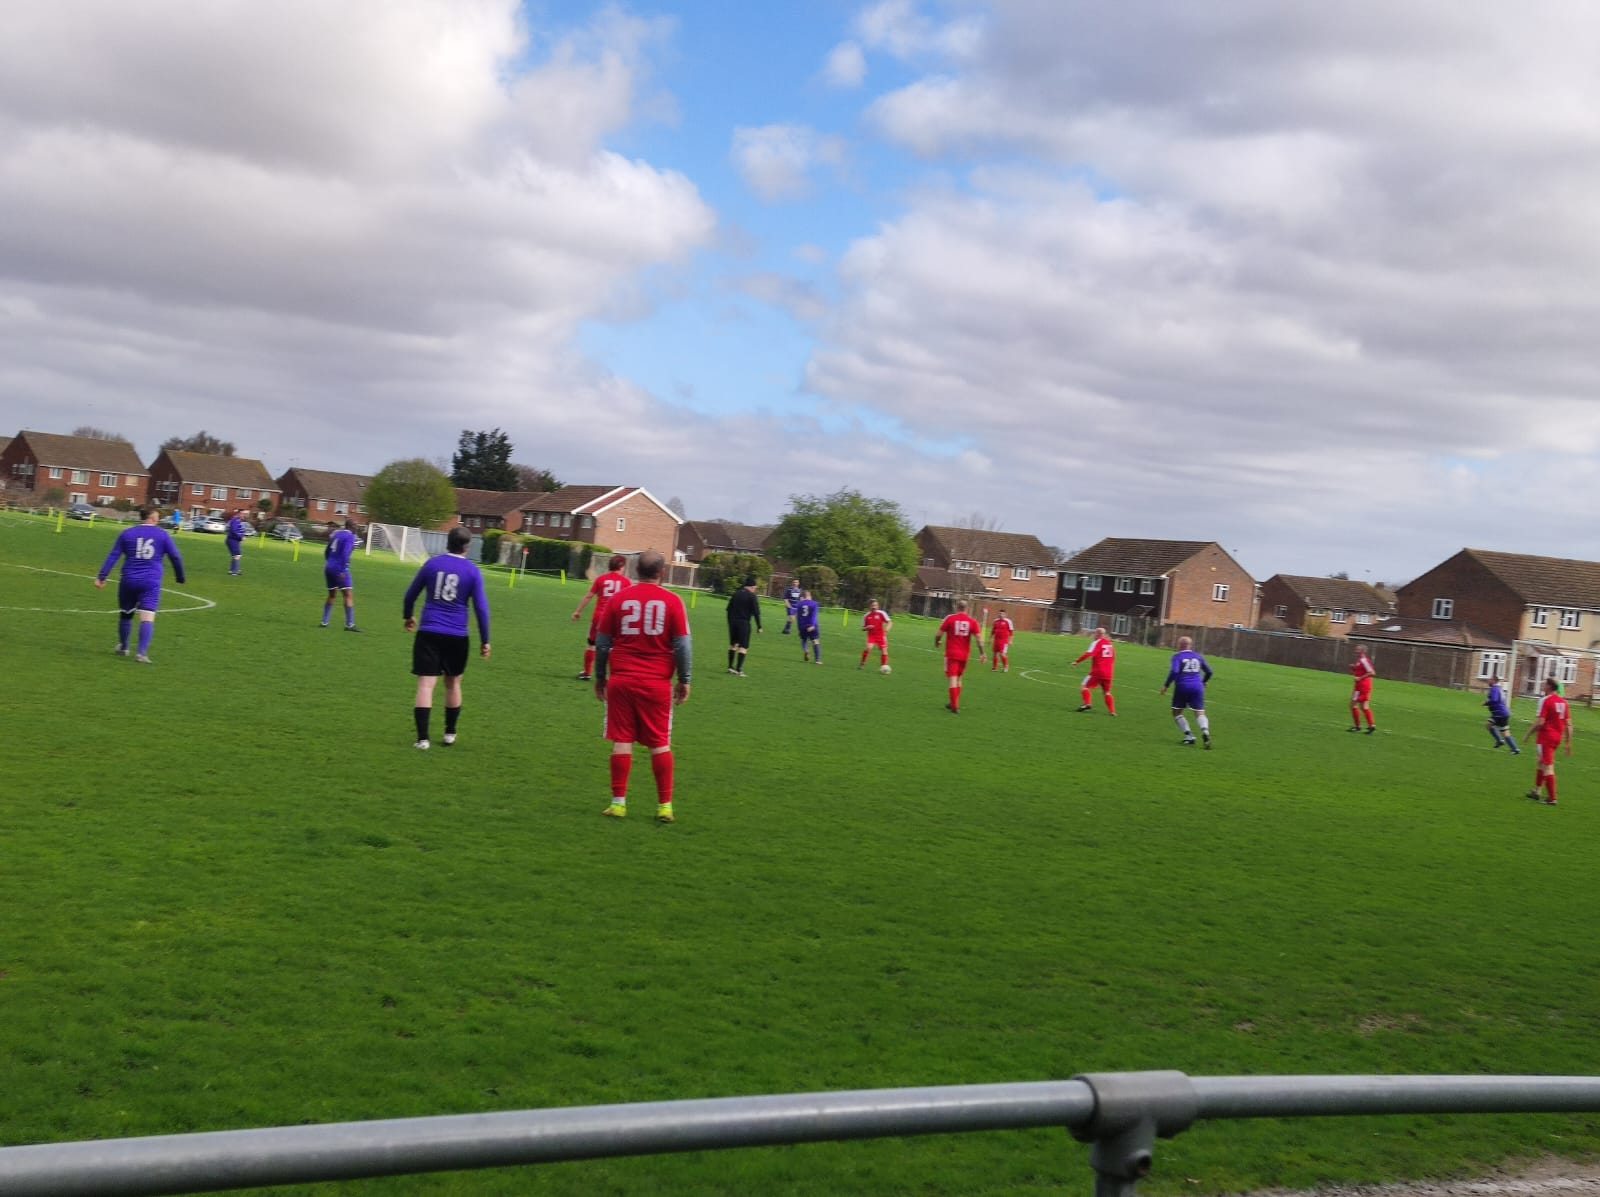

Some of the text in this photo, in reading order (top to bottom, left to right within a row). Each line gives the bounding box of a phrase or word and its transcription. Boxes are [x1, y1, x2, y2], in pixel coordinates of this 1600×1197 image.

[136, 537, 155, 560] 16
[433, 571, 460, 601] 18
[603, 580, 622, 597] 21
[621, 600, 667, 635] 20
[802, 605, 809, 616] 3
[954, 620, 970, 636] 19
[1182, 658, 1200, 672] 20
